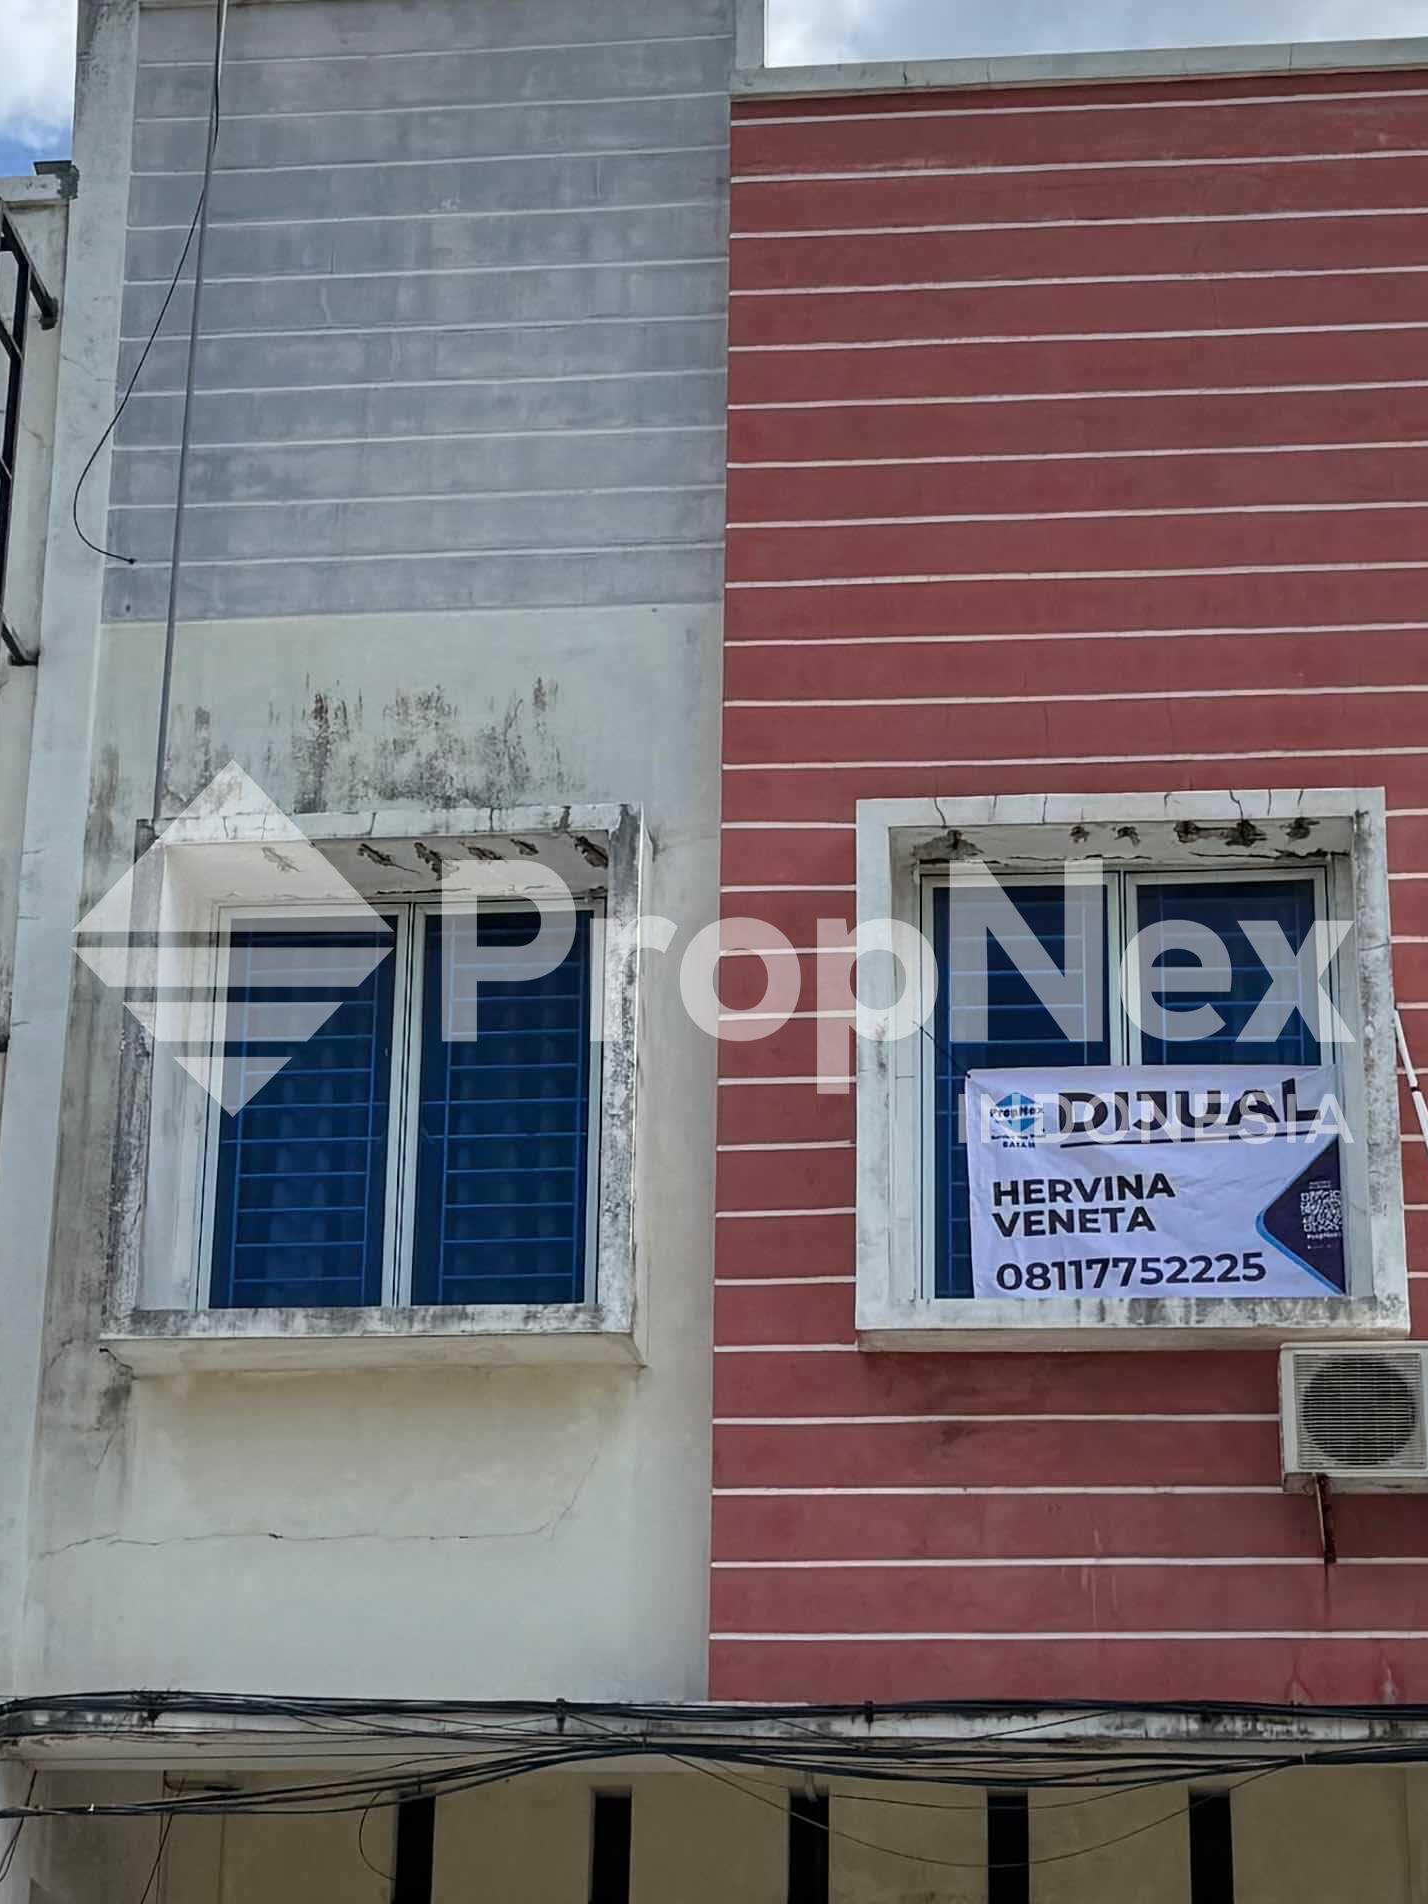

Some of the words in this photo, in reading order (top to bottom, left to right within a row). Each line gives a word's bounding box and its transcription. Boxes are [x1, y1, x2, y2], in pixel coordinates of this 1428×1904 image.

[1058, 1078, 1323, 1134] DIJUAL
[992, 1172, 1176, 1207] HERVINA
[992, 1206, 1156, 1238] VENETA
[996, 1251, 1268, 1292] 08117752225
